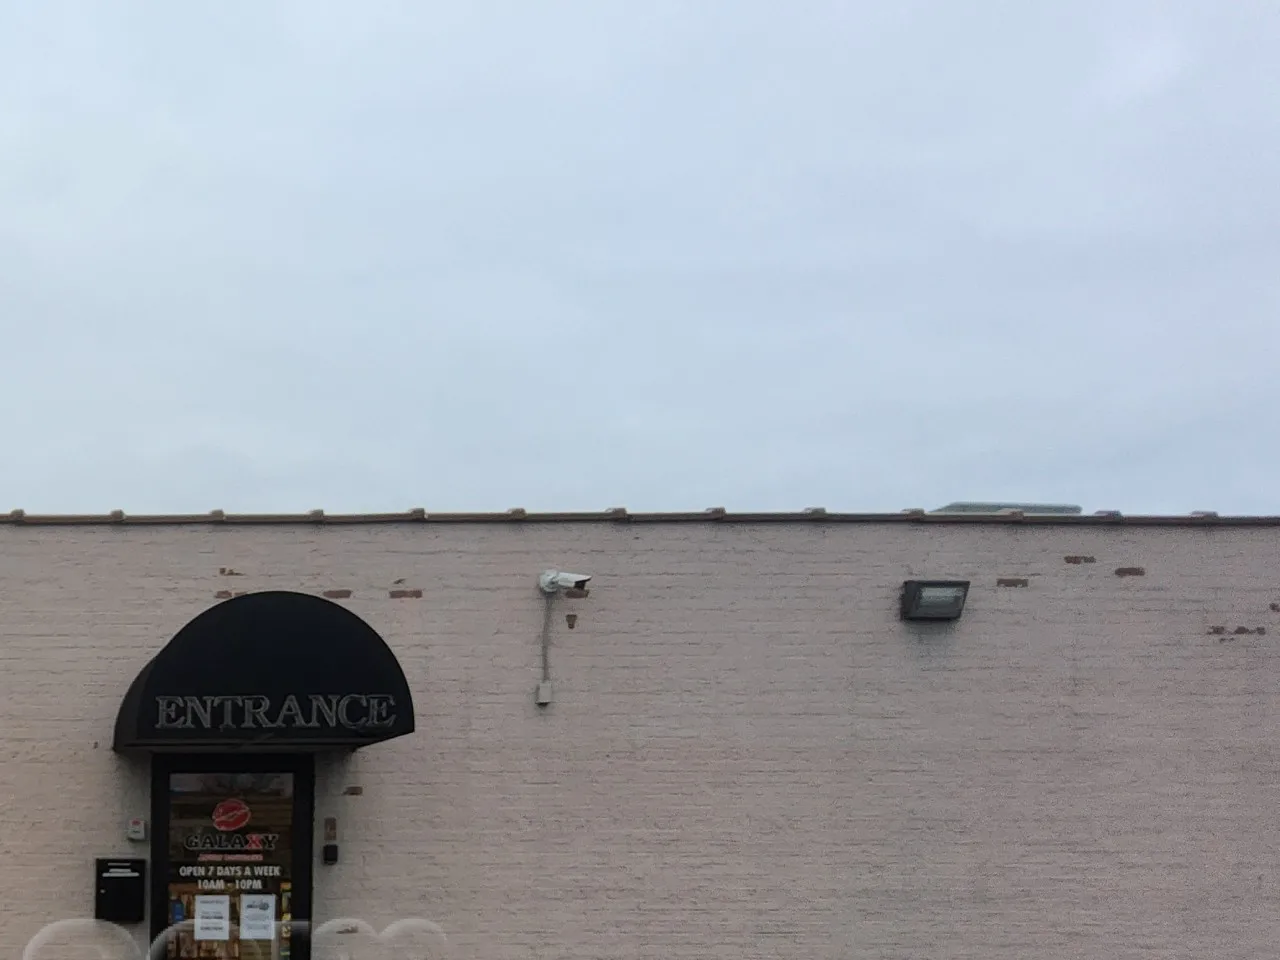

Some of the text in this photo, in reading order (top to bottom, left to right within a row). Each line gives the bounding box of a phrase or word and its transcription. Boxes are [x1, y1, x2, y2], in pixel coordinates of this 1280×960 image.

[154, 694, 396, 729] ENTRANCE
[185, 834, 279, 850] GALAXY
[179, 866, 280, 877] OPEN 7 DAYS A WEEK
[197, 879, 224, 889] 10AM
[236, 879, 262, 889] 10PM
